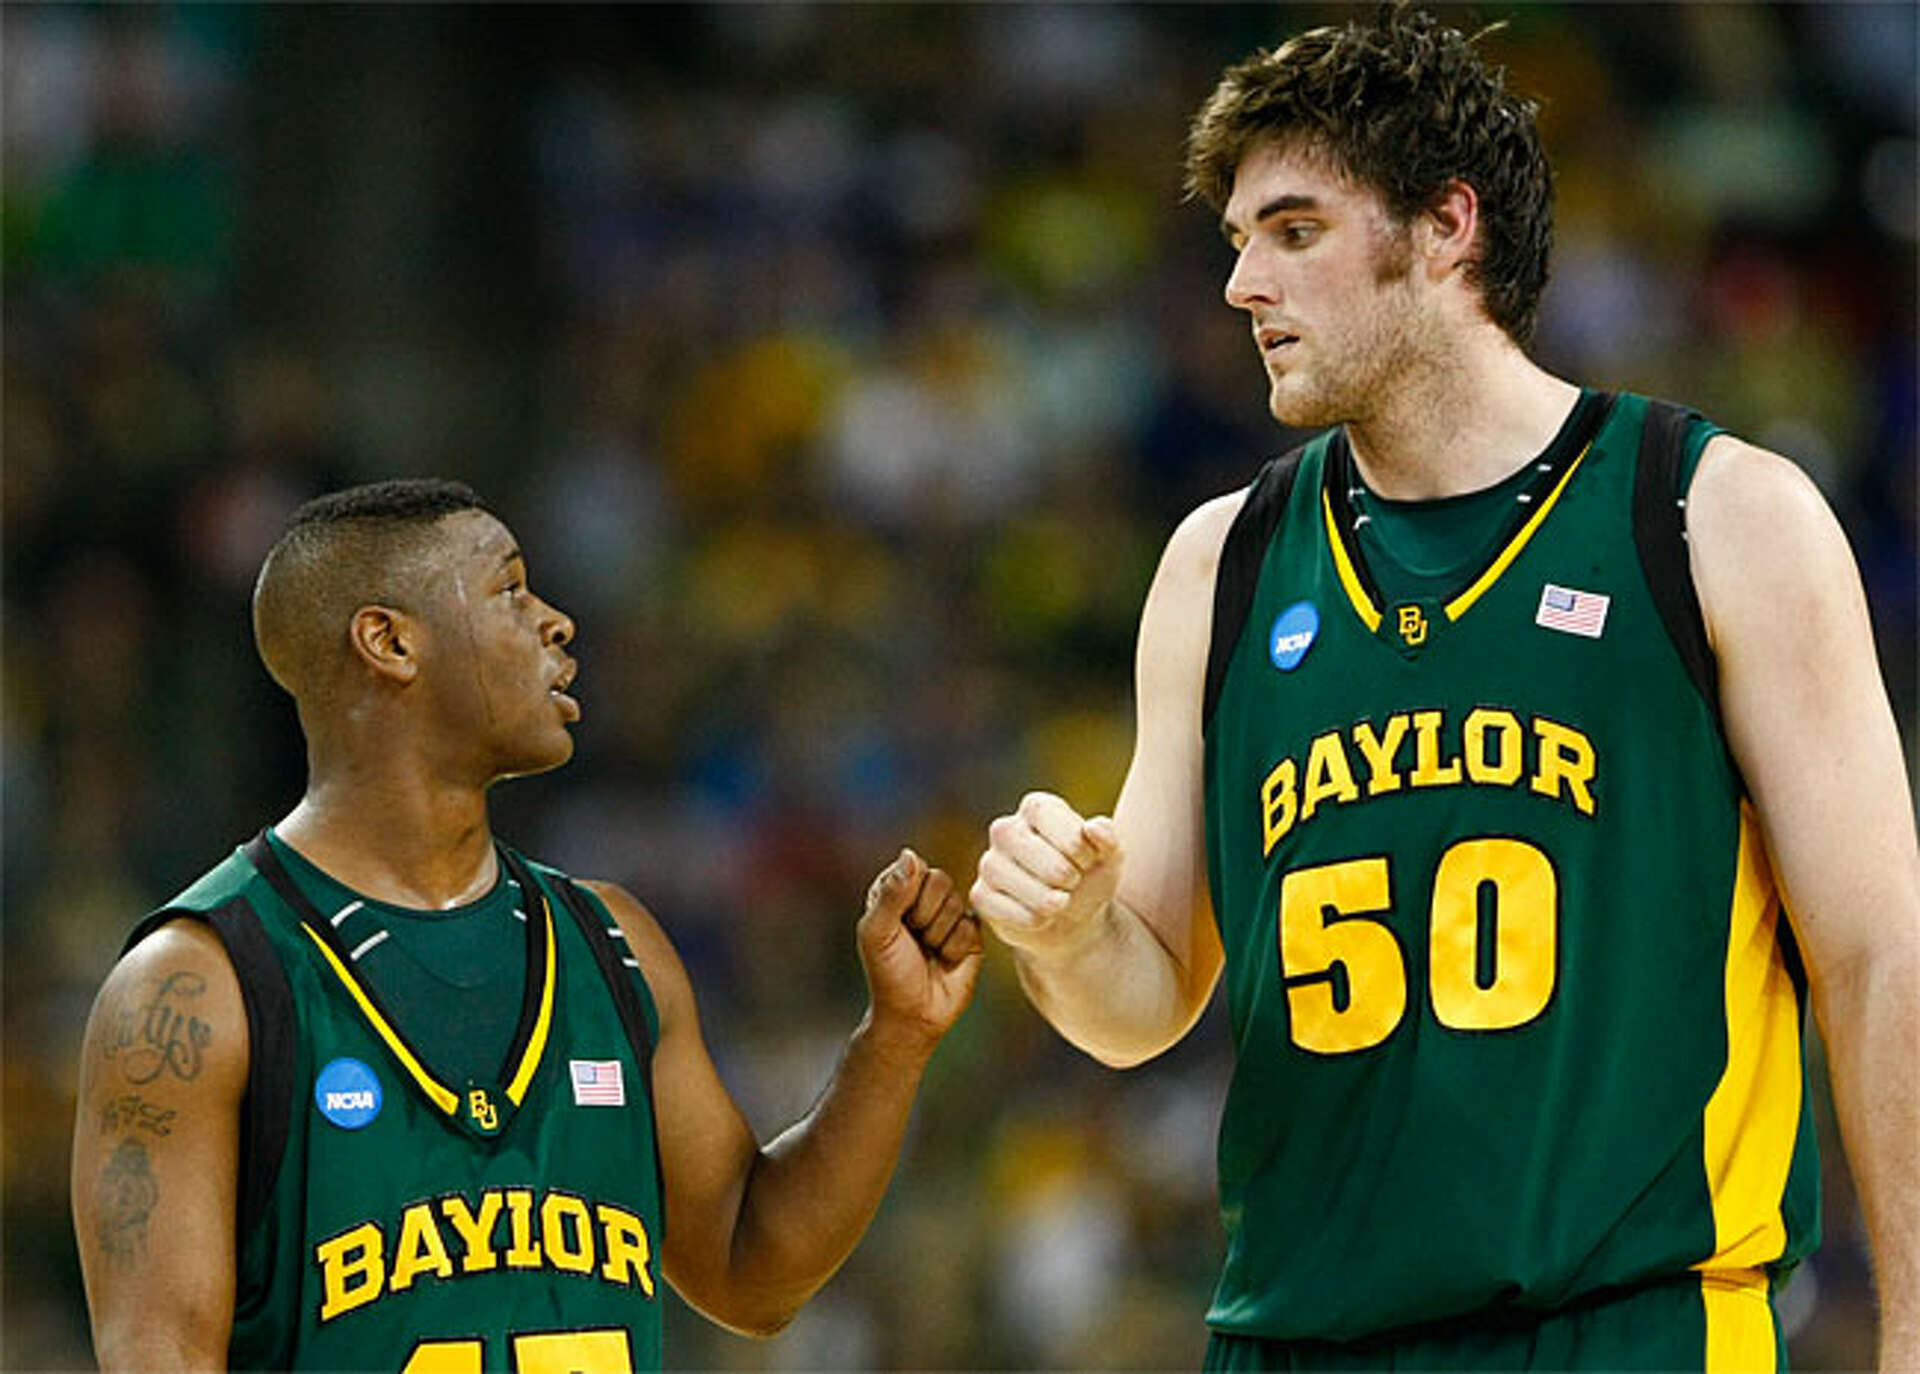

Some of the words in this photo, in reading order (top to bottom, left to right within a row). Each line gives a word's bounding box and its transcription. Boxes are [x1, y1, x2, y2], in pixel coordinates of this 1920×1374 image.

[1259, 706, 1598, 859] BAYLOR
[1278, 836, 1559, 1055] 50
[326, 1091, 375, 1111] NCAA
[315, 1188, 656, 1322] BAYLOR
